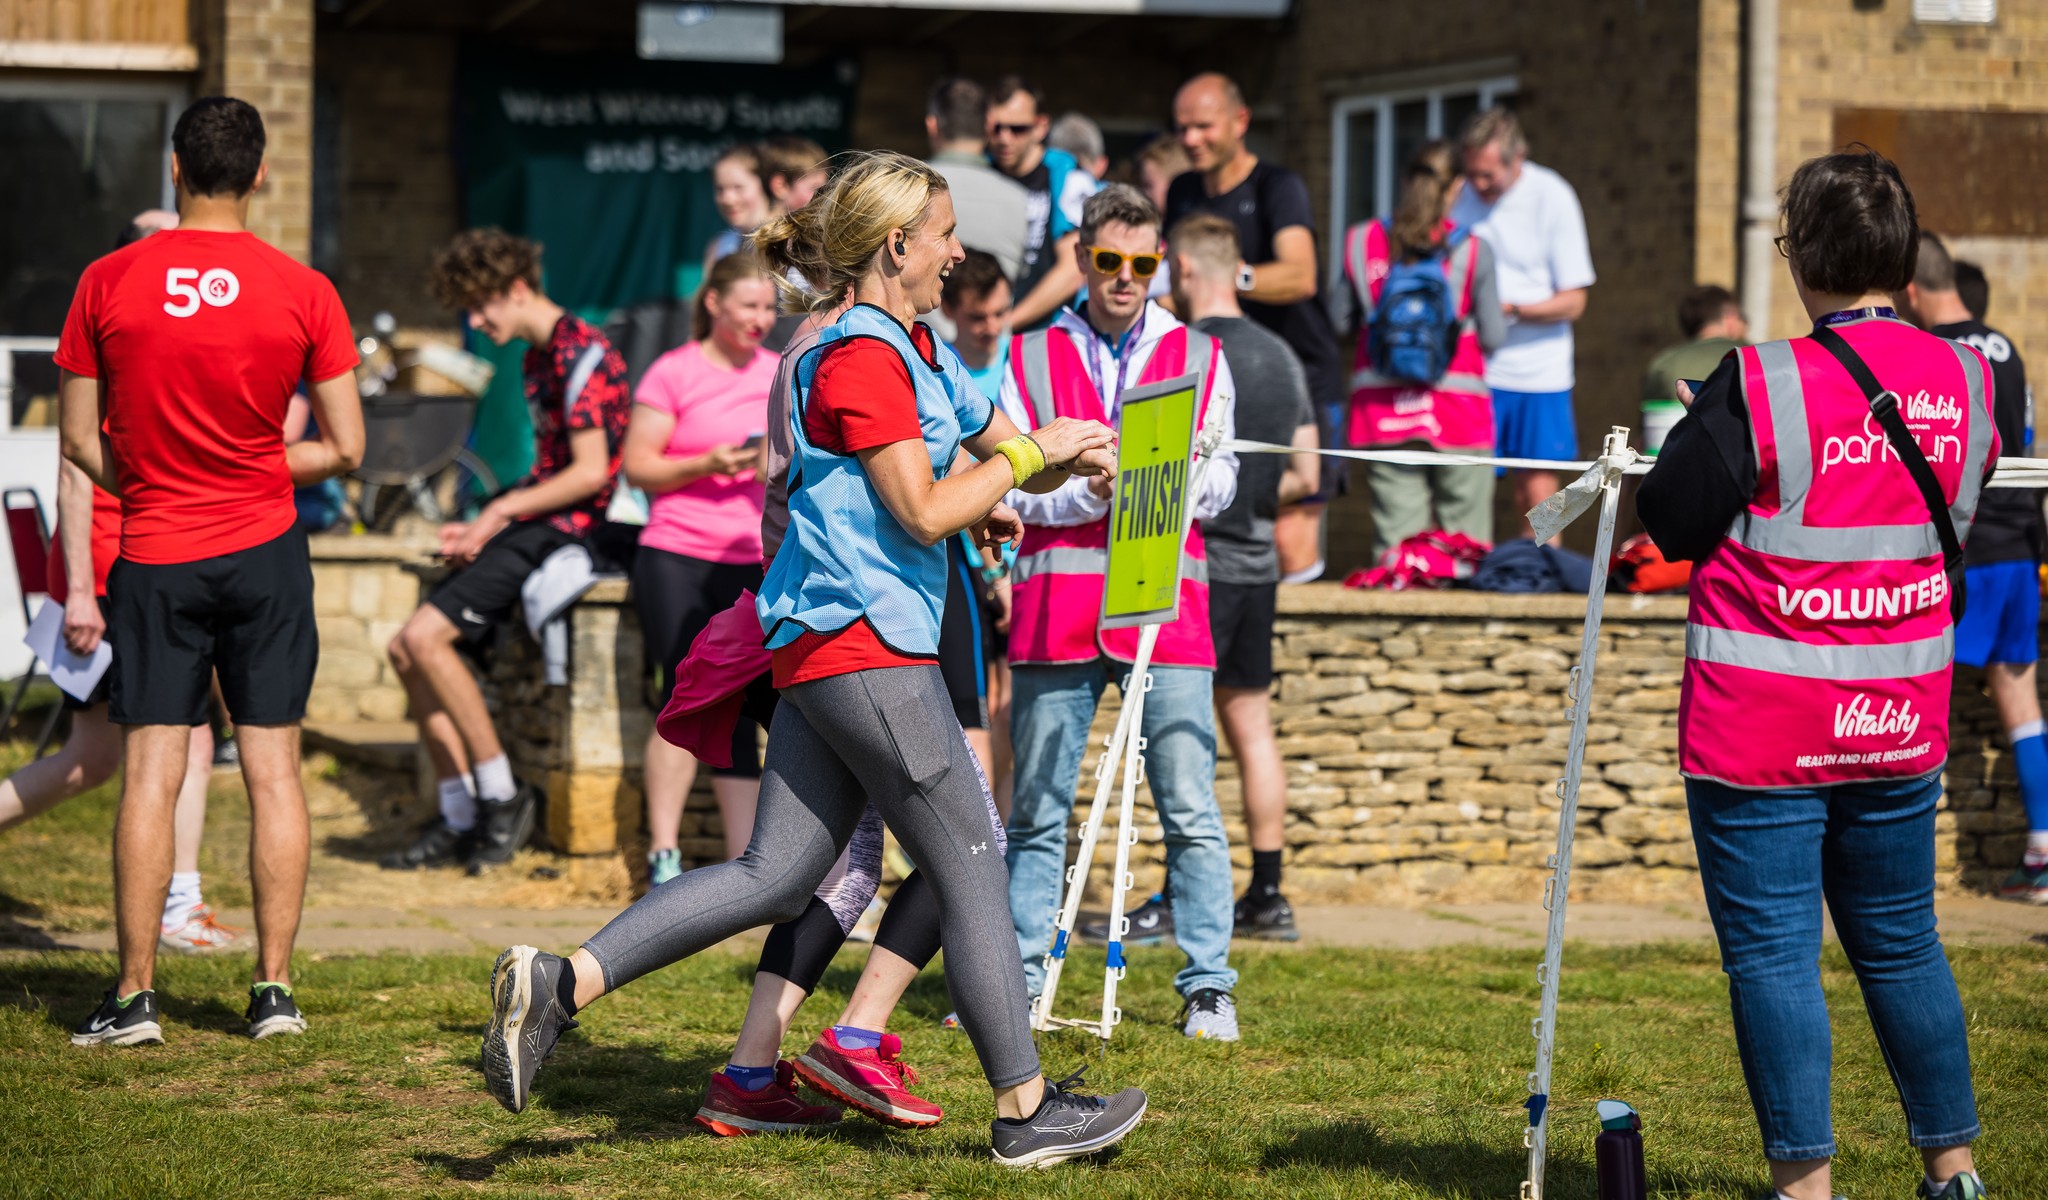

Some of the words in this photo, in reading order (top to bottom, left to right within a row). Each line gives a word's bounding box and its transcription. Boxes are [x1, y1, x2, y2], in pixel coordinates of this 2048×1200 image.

[501, 89, 592, 126] West
[597, 90, 727, 131] Witney
[585, 137, 656, 172] and
[163, 267, 240, 318] 50
[1906, 389, 1963, 430] Vitality
[1821, 431, 1962, 475] parkun
[1116, 459, 1184, 543] FINISH
[1777, 569, 1948, 620] VOLUNTEER
[1834, 692, 1920, 746] Vitality
[1796, 754, 1837, 768] HEALTH
[1837, 753, 1861, 764] AND
[1861, 752, 1882, 764] LIFE
[1882, 741, 1932, 763] INSURANCE
